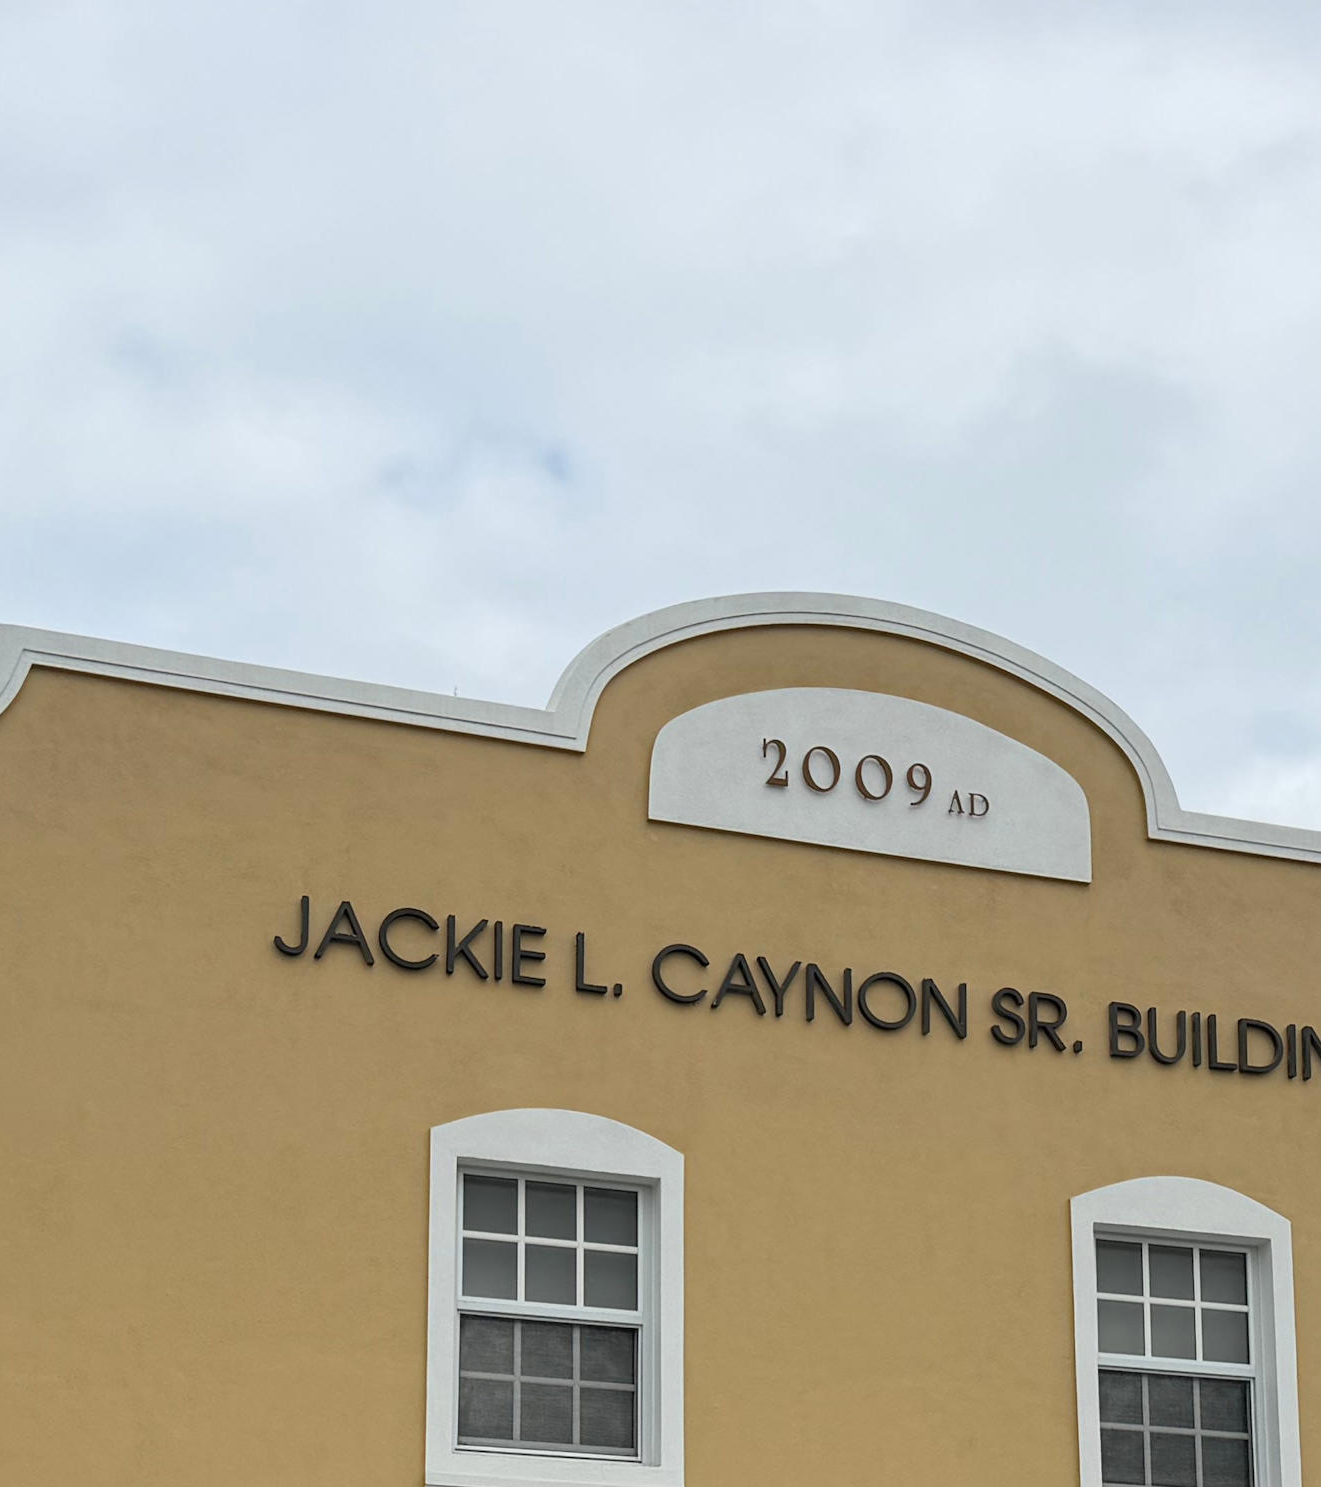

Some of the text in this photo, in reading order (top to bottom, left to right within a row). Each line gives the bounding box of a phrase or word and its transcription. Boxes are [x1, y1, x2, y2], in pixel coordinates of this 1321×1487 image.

[762, 738, 990, 816] 2009 AD
[273, 895, 548, 987] JACKIE
[575, 932, 623, 997] L.
[651, 943, 968, 1040] CAYNON
[990, 987, 1083, 1054] SR.
